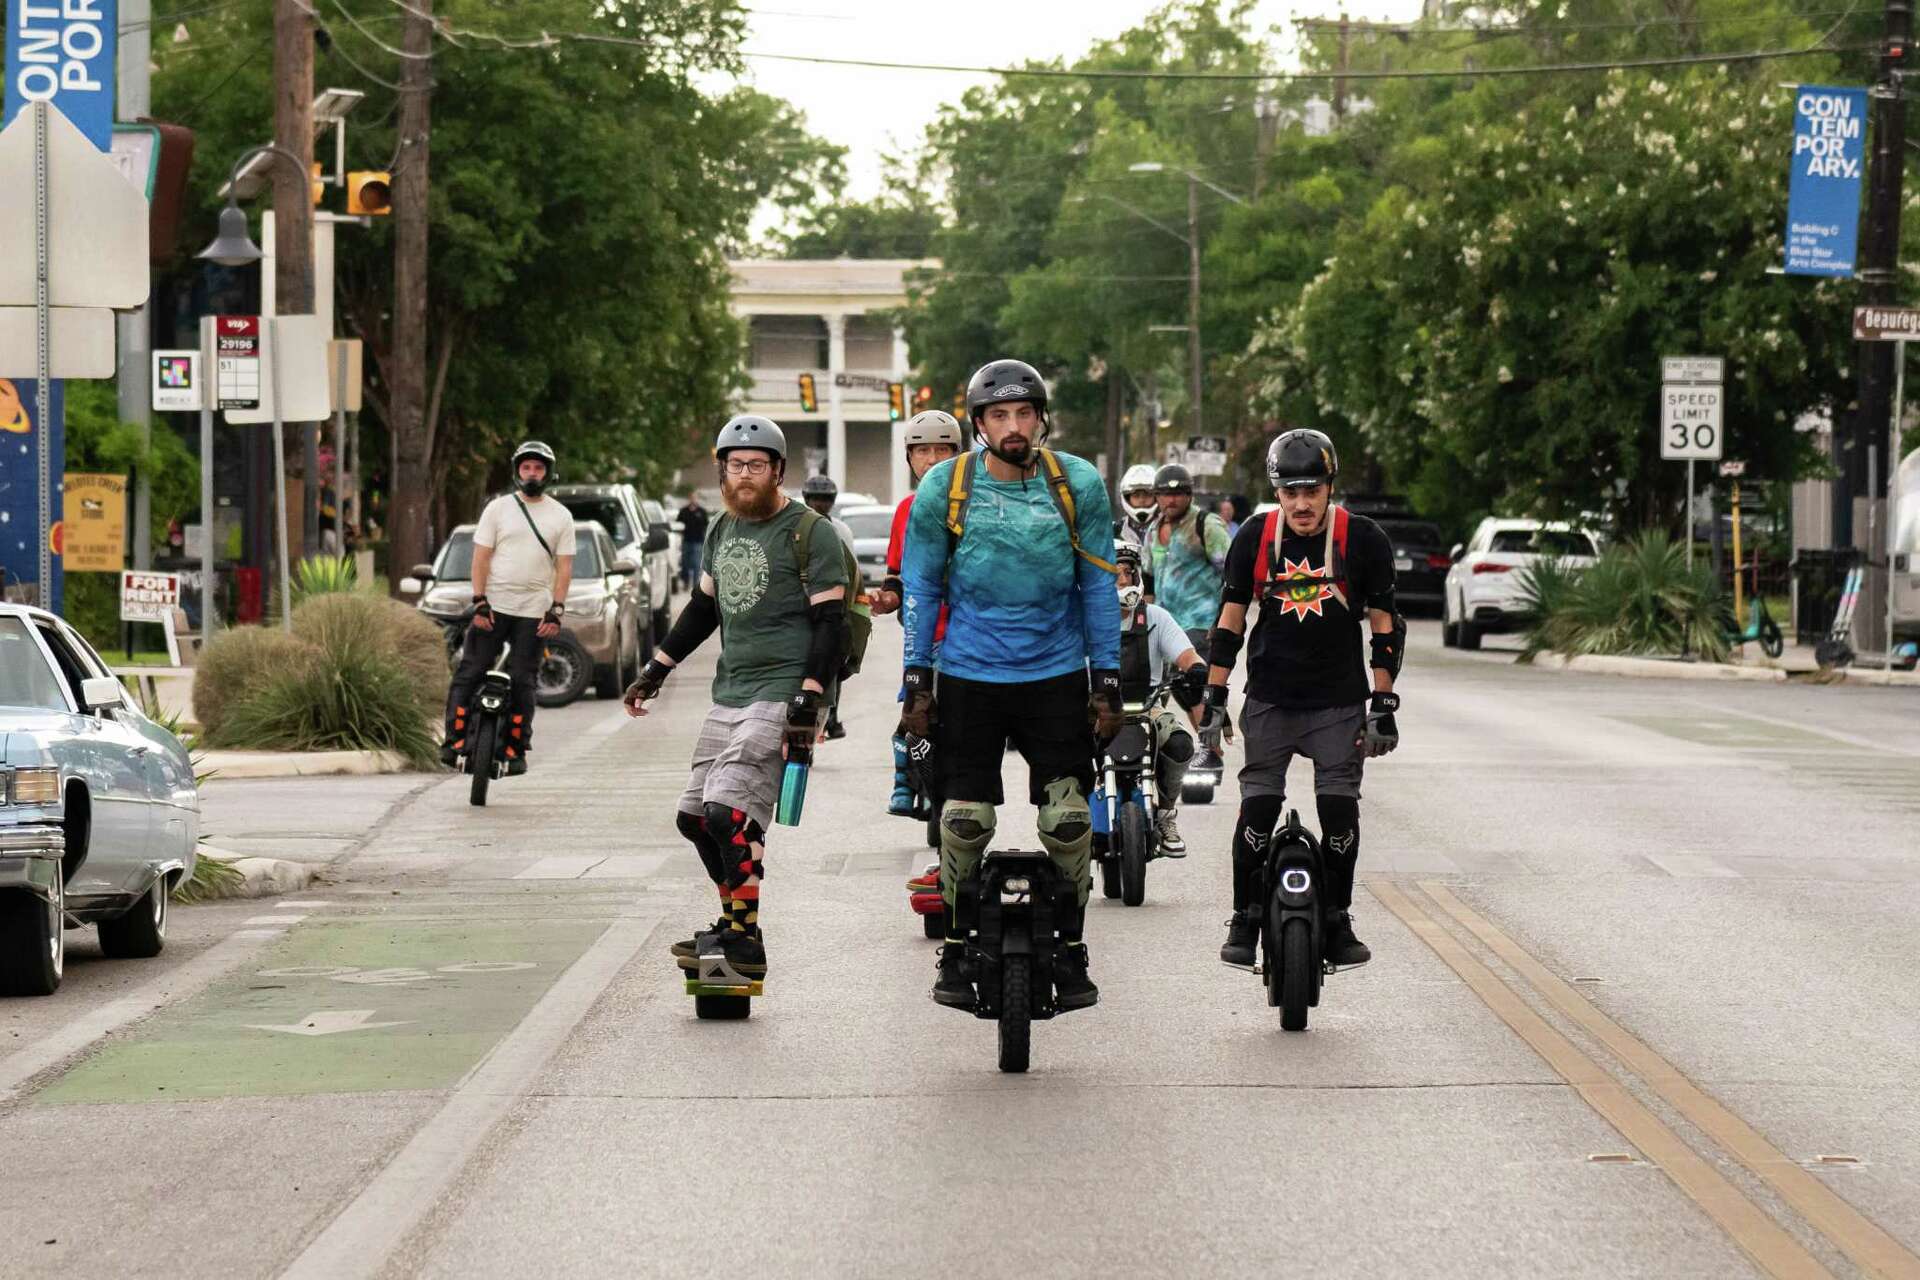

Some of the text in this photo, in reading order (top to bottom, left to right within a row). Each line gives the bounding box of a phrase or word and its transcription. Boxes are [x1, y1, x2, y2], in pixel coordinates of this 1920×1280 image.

[1798, 95, 1851, 118] CON
[1808, 117, 1860, 138] TEM
[1795, 135, 1845, 158] POR
[1807, 157, 1860, 178] ARY.
[1791, 223, 1839, 237] Building C
[221, 340, 252, 350] 29196
[1667, 394, 1716, 405] SPEED
[1673, 409, 1710, 420] LIMIT
[1669, 423, 1715, 450] 30
[131, 576, 169, 591] FOR
[126, 589, 175, 603] RENT
